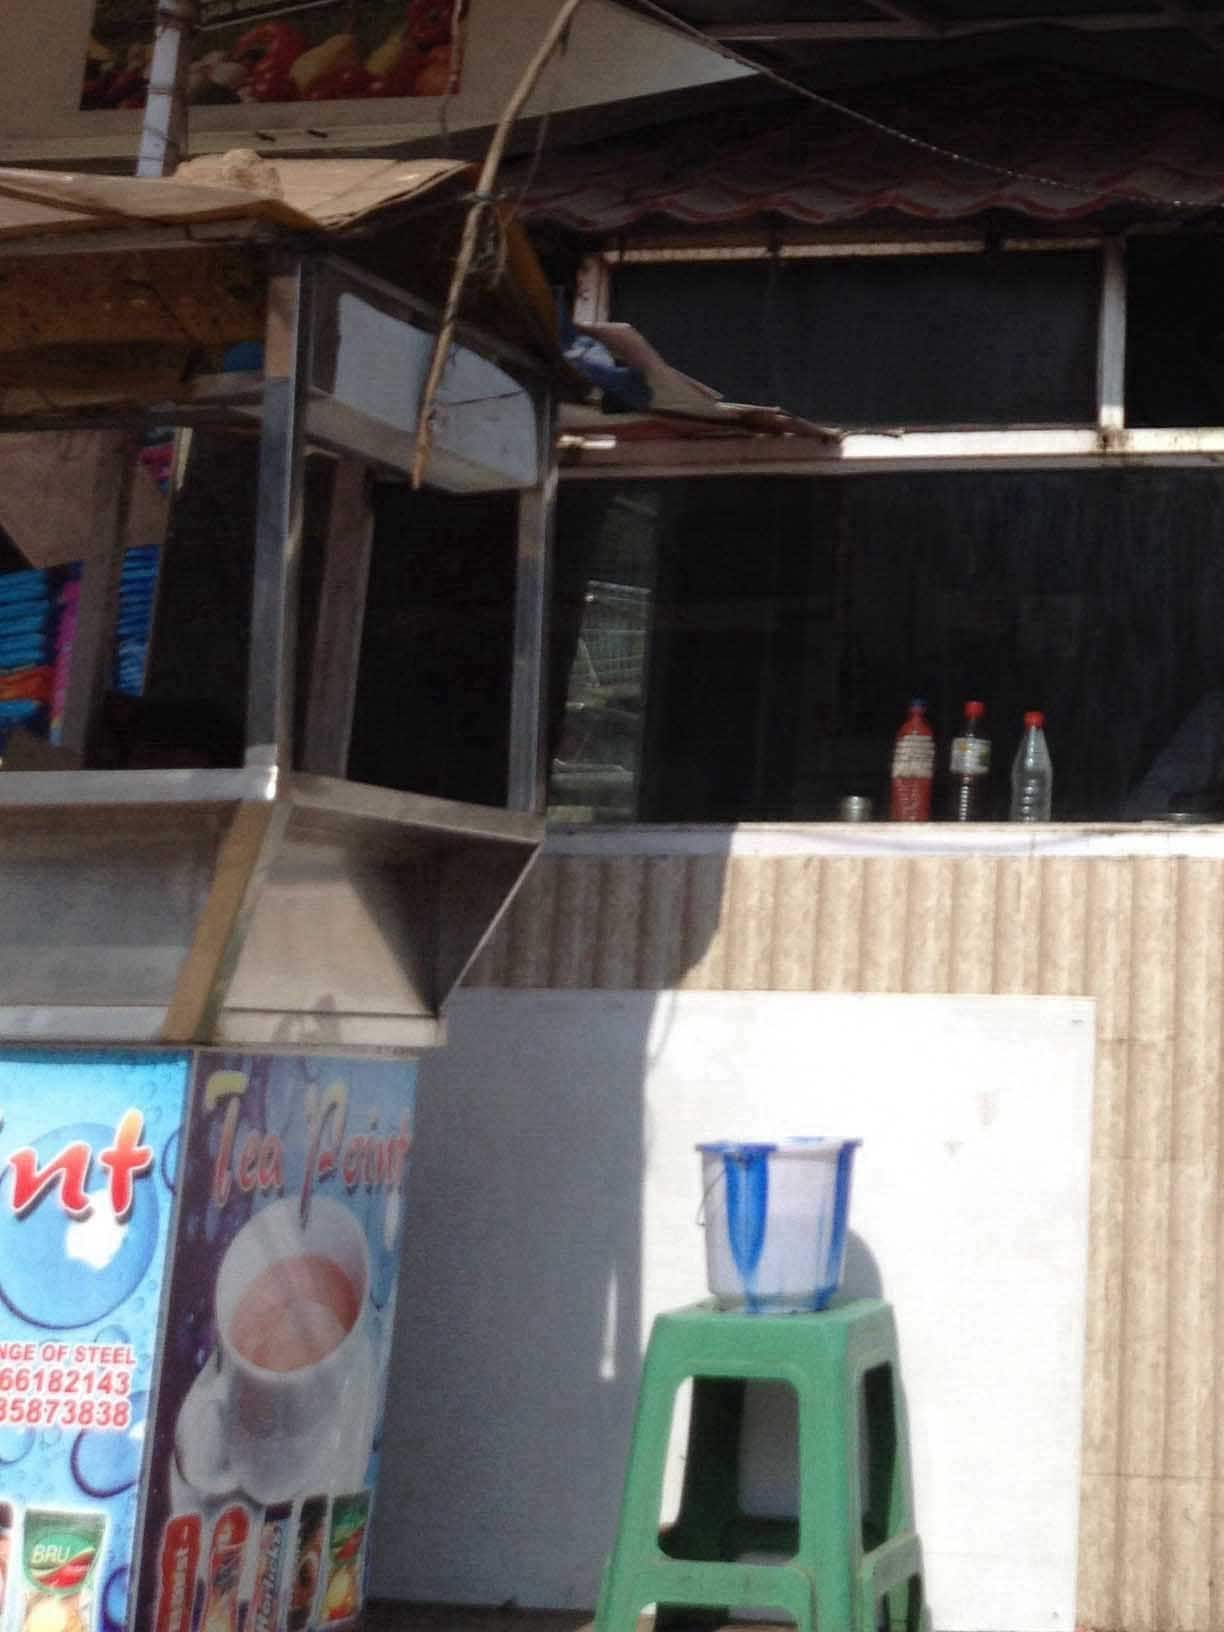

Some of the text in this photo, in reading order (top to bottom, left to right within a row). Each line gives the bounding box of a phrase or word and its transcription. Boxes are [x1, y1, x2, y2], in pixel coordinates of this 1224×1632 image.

[42, 1344, 68, 1362] OF
[74, 1345, 136, 1365] STEEL
[31, 1543, 71, 1564] BRU
